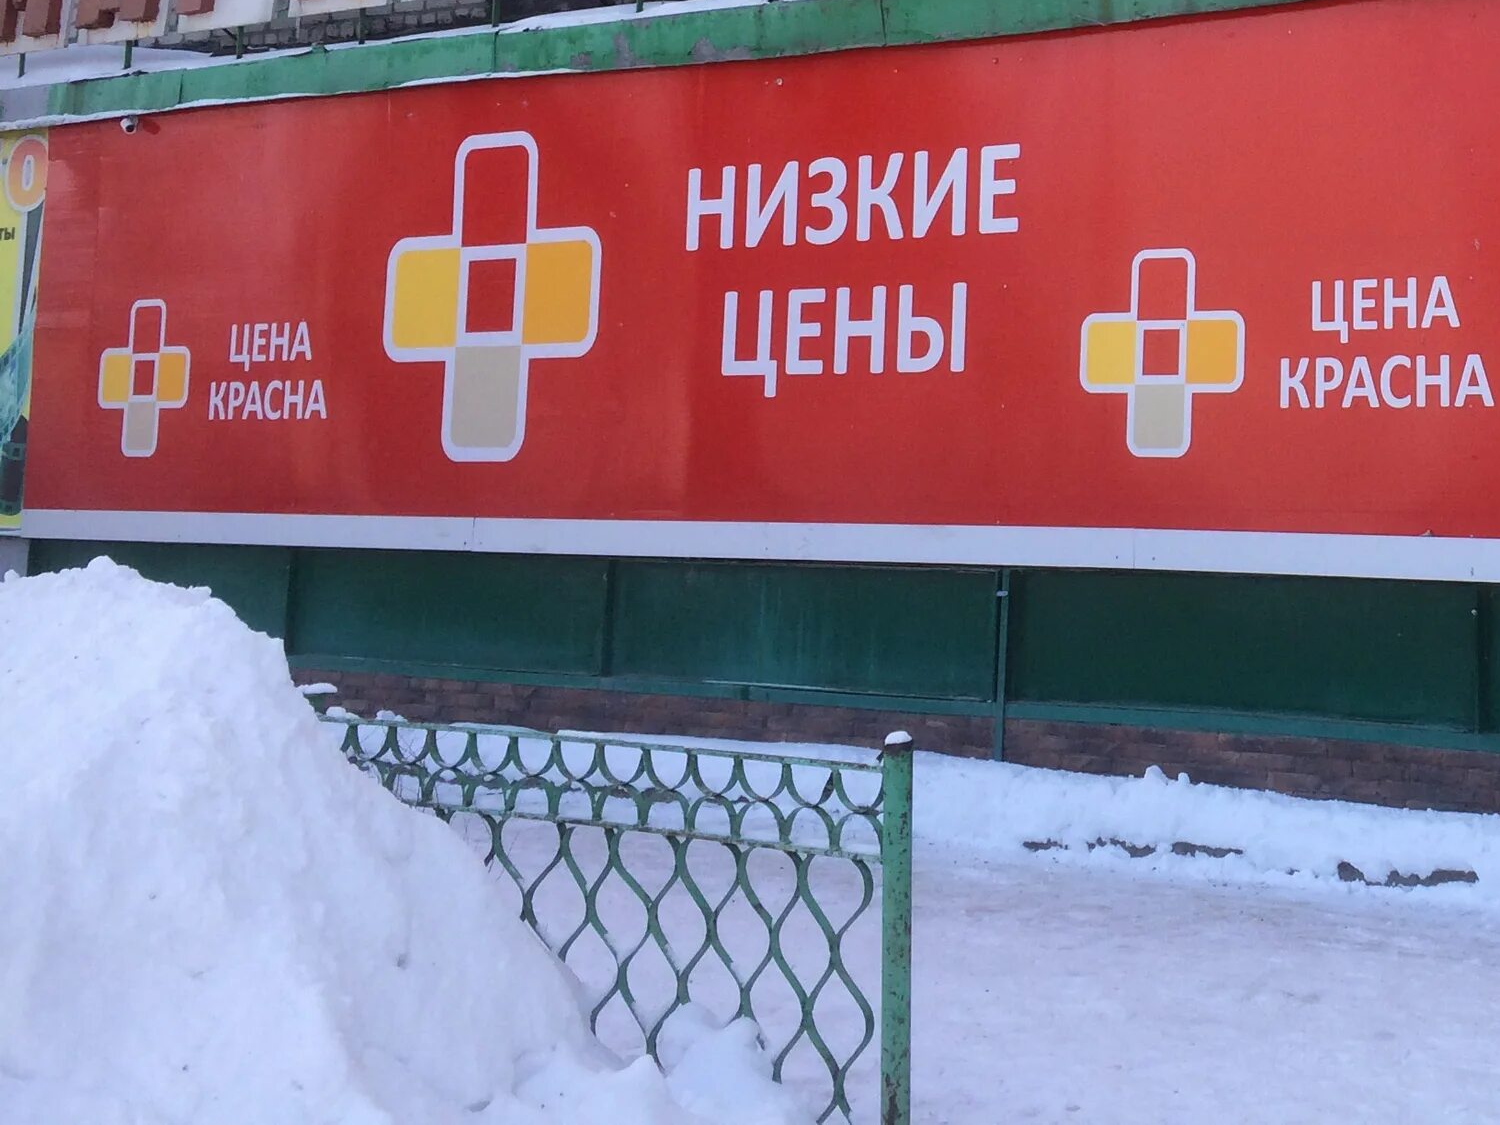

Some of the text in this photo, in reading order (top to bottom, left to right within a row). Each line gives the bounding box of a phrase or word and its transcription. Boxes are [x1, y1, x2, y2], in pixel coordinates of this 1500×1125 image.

[685, 143, 1021, 252] НИЗКИЕ
[721, 282, 968, 399] ЦЕНЫ
[1311, 275, 1461, 344] ЦЕНА
[228, 321, 312, 366] ЦЕНА
[208, 379, 327, 421] КРАСНА
[1279, 353, 1495, 409] КРАСНА
